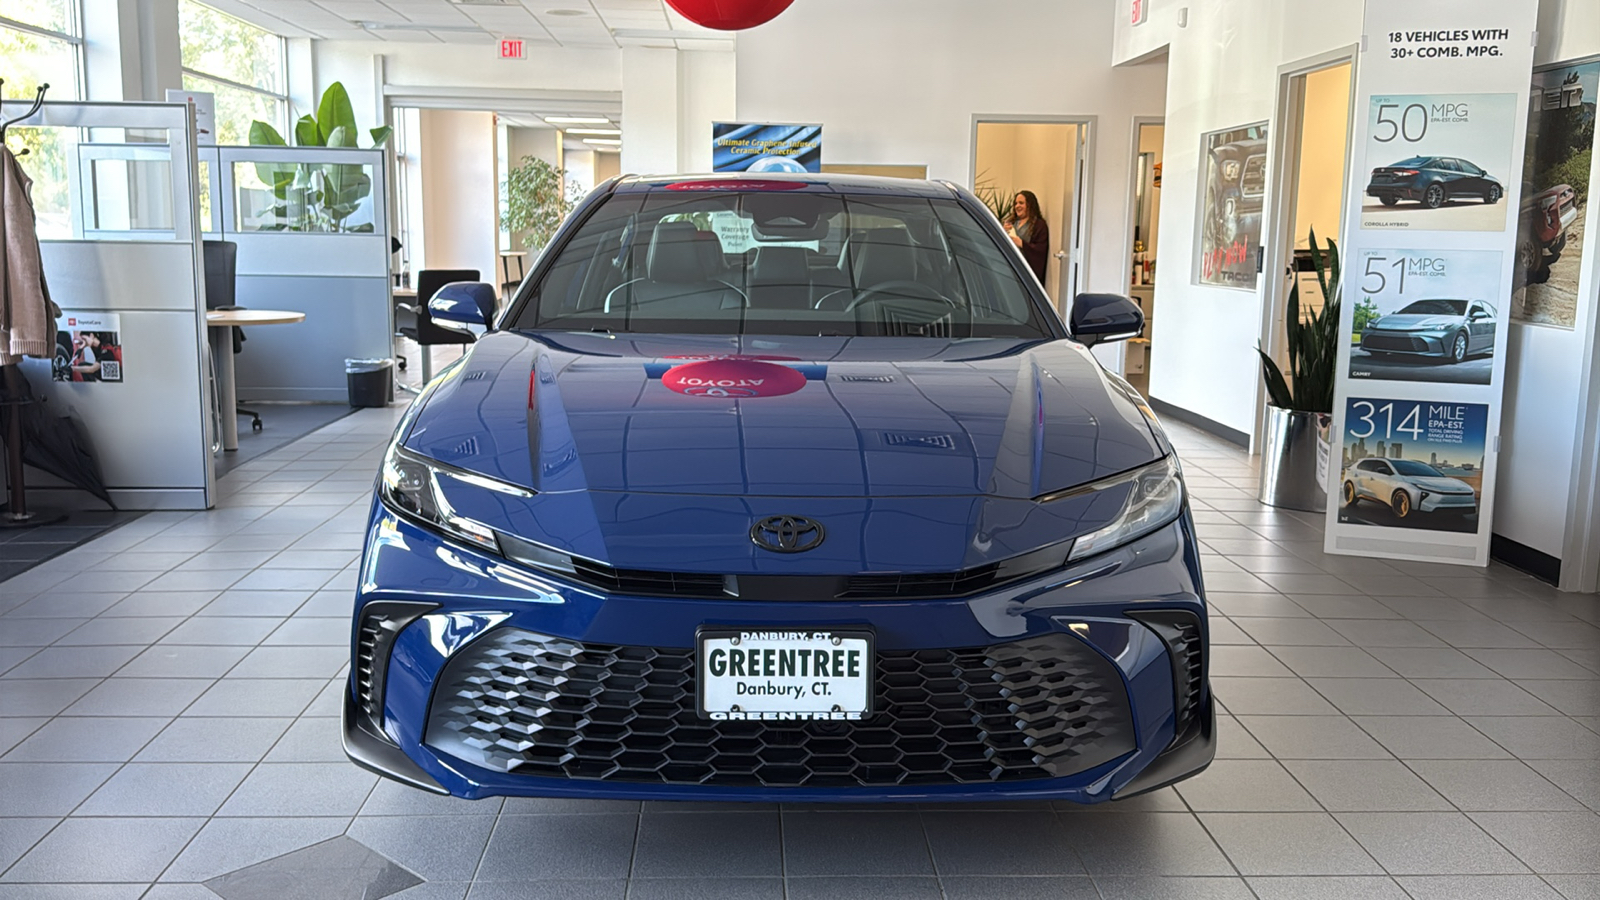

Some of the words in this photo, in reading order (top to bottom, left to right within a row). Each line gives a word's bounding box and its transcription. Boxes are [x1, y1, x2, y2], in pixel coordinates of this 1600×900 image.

[1388, 32, 1402, 43] 18
[1405, 30, 1469, 42] VEHICLES
[1472, 29, 1509, 40] WITH
[501, 40, 523, 58] EXIT
[1390, 48, 1413, 58] 30+
[1416, 47, 1463, 58] COMB.
[1466, 46, 1503, 57] MPG.
[1373, 103, 1428, 143] 50
[1431, 103, 1469, 118] MPG
[717, 138, 750, 147] Ultimate
[730, 146, 760, 154] Ceramic
[762, 147, 801, 156] Protection
[721, 226, 750, 234] Warranty
[1361, 257, 1406, 295] 51
[1408, 257, 1446, 272] MPG
[1349, 401, 1424, 441] 314
[1428, 405, 1465, 421] MILE
[1428, 420, 1465, 430] EPA-EST.
[740, 632, 809, 642] DANBURY,
[709, 648, 860, 678] GREENTREE
[736, 680, 806, 699] Danbury,
[811, 682, 832, 696] CT.
[709, 711, 862, 721] GREENTREE
